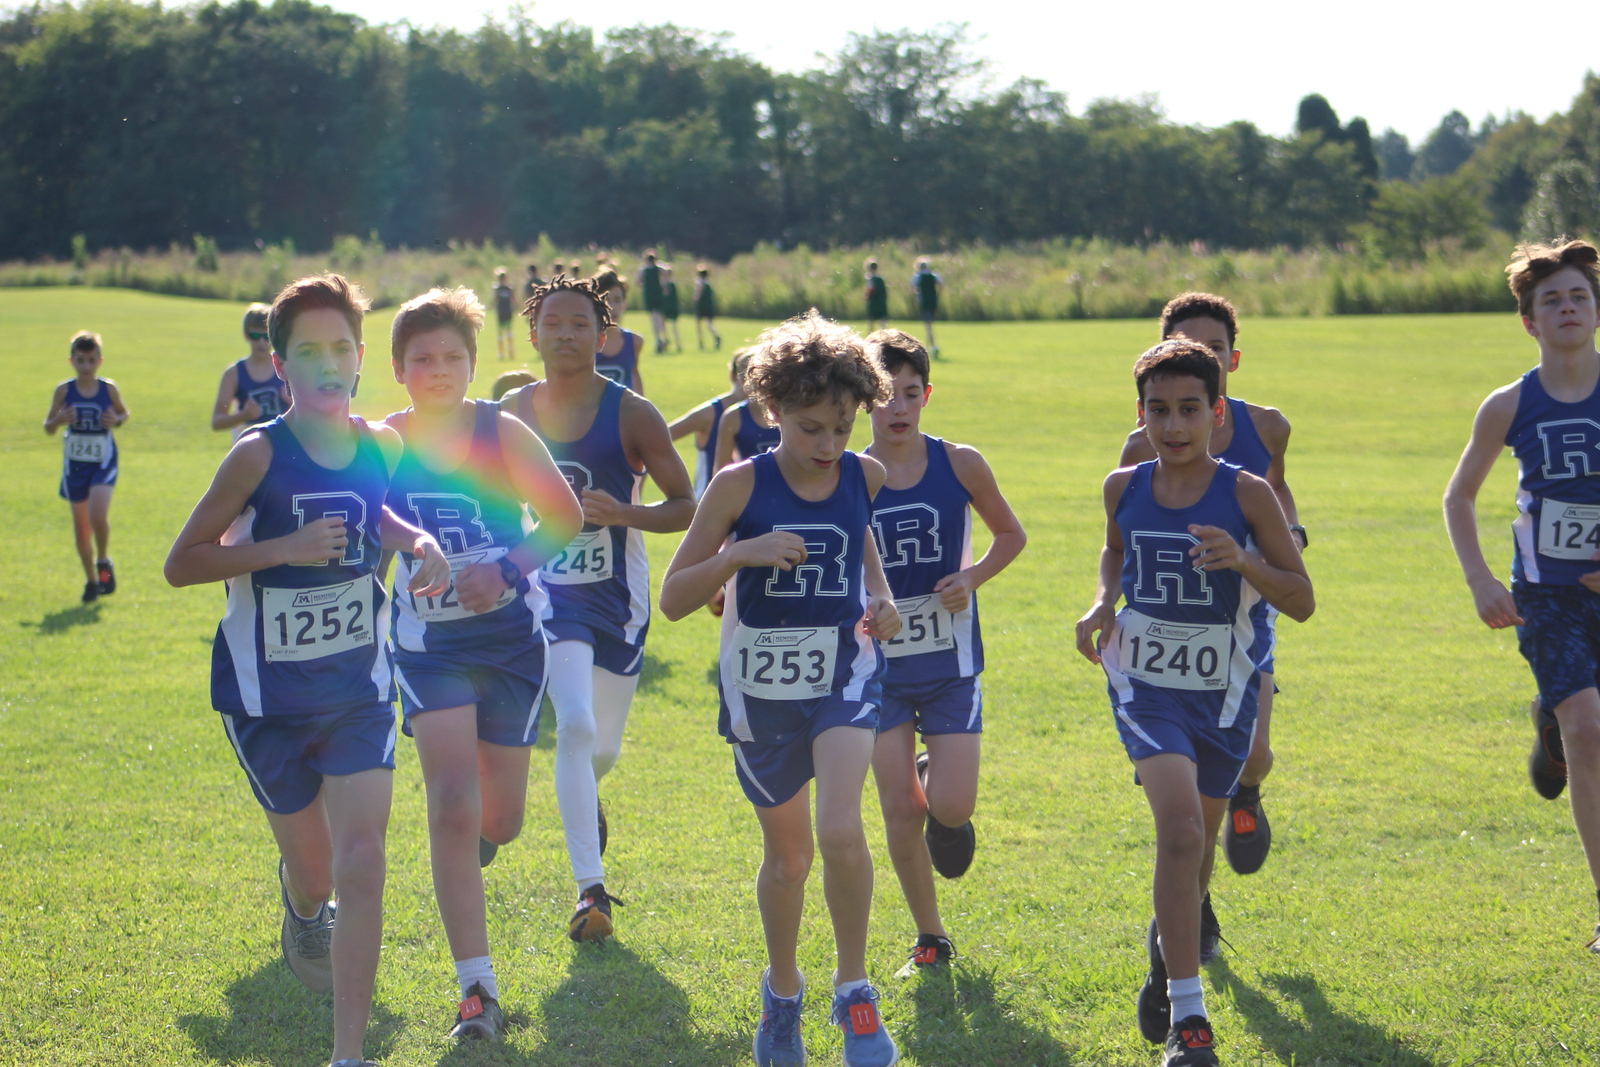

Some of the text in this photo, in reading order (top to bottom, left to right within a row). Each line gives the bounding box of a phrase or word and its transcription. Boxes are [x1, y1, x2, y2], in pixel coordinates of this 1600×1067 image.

[71, 402, 102, 430] R
[70, 442, 102, 457] 1243
[1536, 418, 1600, 480] R
[289, 491, 366, 566] R
[407, 493, 493, 554] R
[872, 503, 943, 568] R
[765, 524, 848, 597] R
[1131, 531, 1212, 606] R
[275, 600, 364, 646] 1252
[739, 648, 825, 684] 1253
[1130, 636, 1218, 678] 1240
